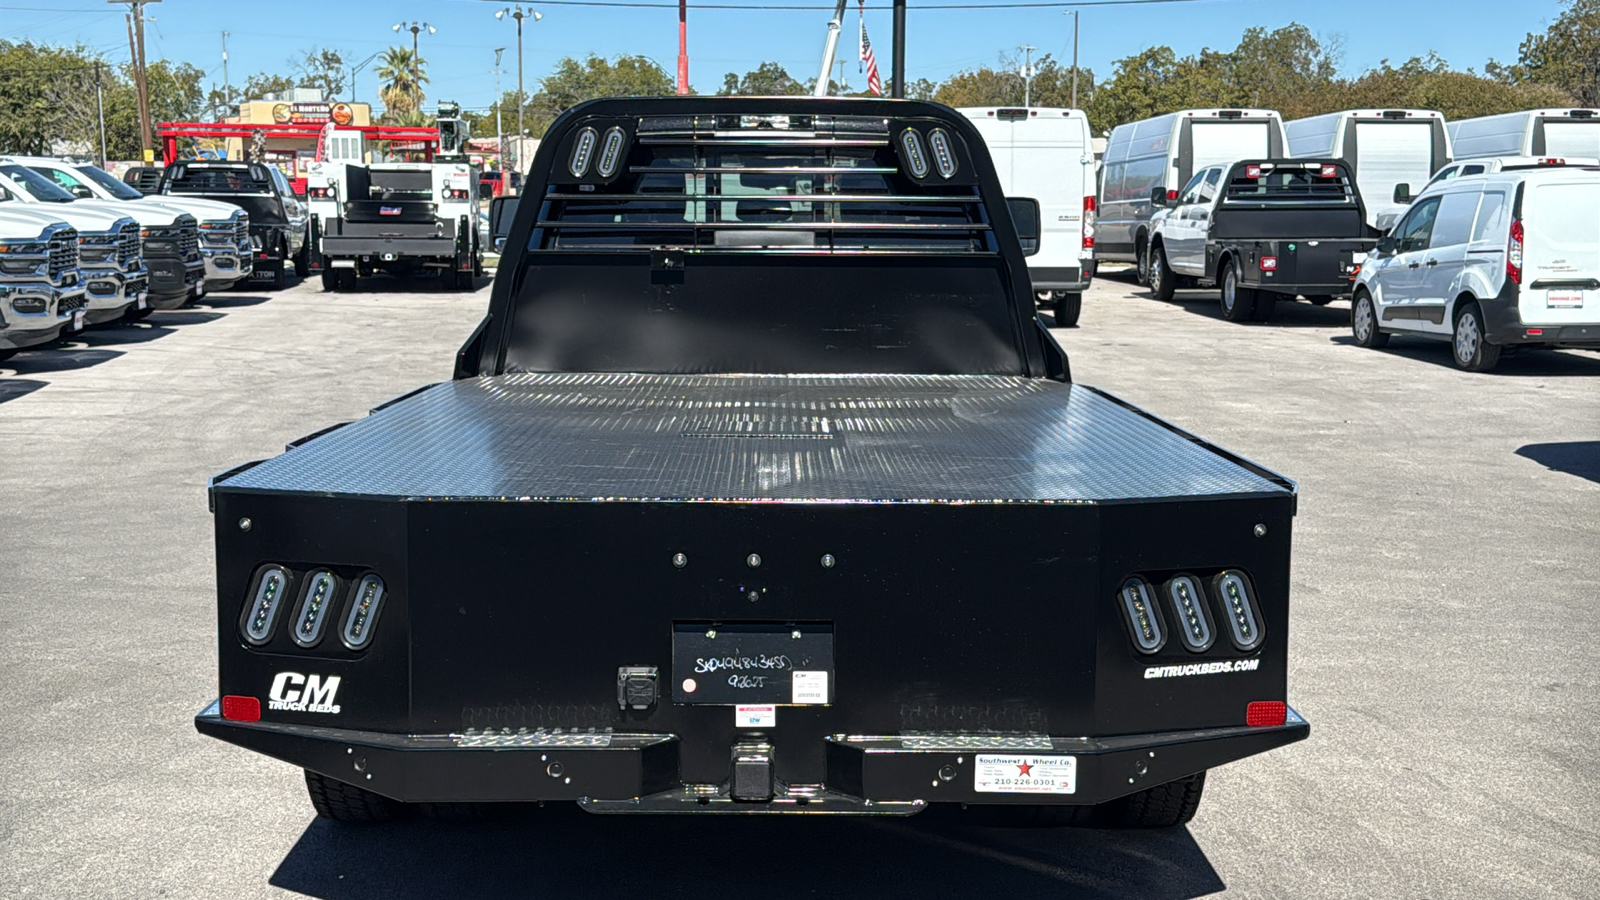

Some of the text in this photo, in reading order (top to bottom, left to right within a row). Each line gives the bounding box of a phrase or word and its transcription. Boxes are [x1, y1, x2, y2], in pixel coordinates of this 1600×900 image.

[1144, 659, 1259, 679] CMTRUCKBEDS.COM
[269, 672, 341, 705] CM
[268, 701, 341, 714] TRUCK BEDS
